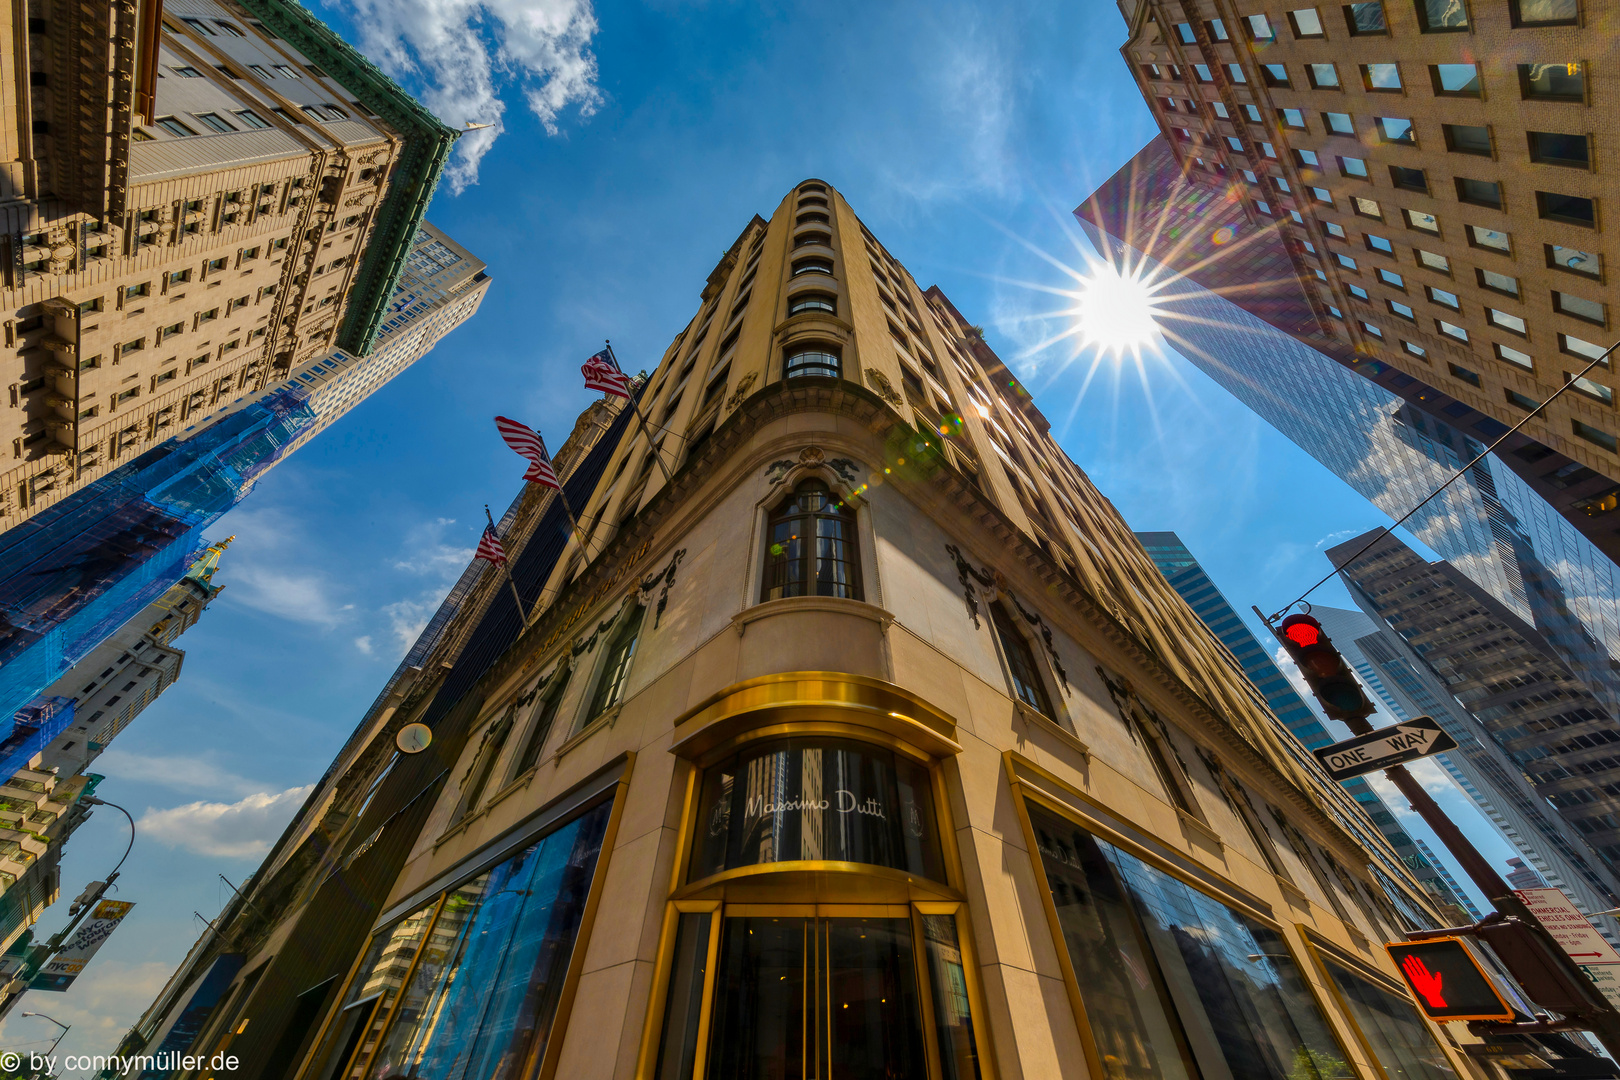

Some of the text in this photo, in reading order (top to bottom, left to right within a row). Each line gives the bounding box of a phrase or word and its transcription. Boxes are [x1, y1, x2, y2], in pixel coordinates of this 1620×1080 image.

[1330, 747, 1372, 768] ONE
[1386, 729, 1428, 751] WAY
[744, 789, 886, 820] Massimo Dutti
[1537, 914, 1565, 922] EHICLES
[60, 916, 125, 954] Restaurant
[76, 920, 104, 939] NYC
[78, 930, 111, 950] Week
[46, 962, 83, 974] nycgo
[1485, 1045, 1503, 1053] 689
